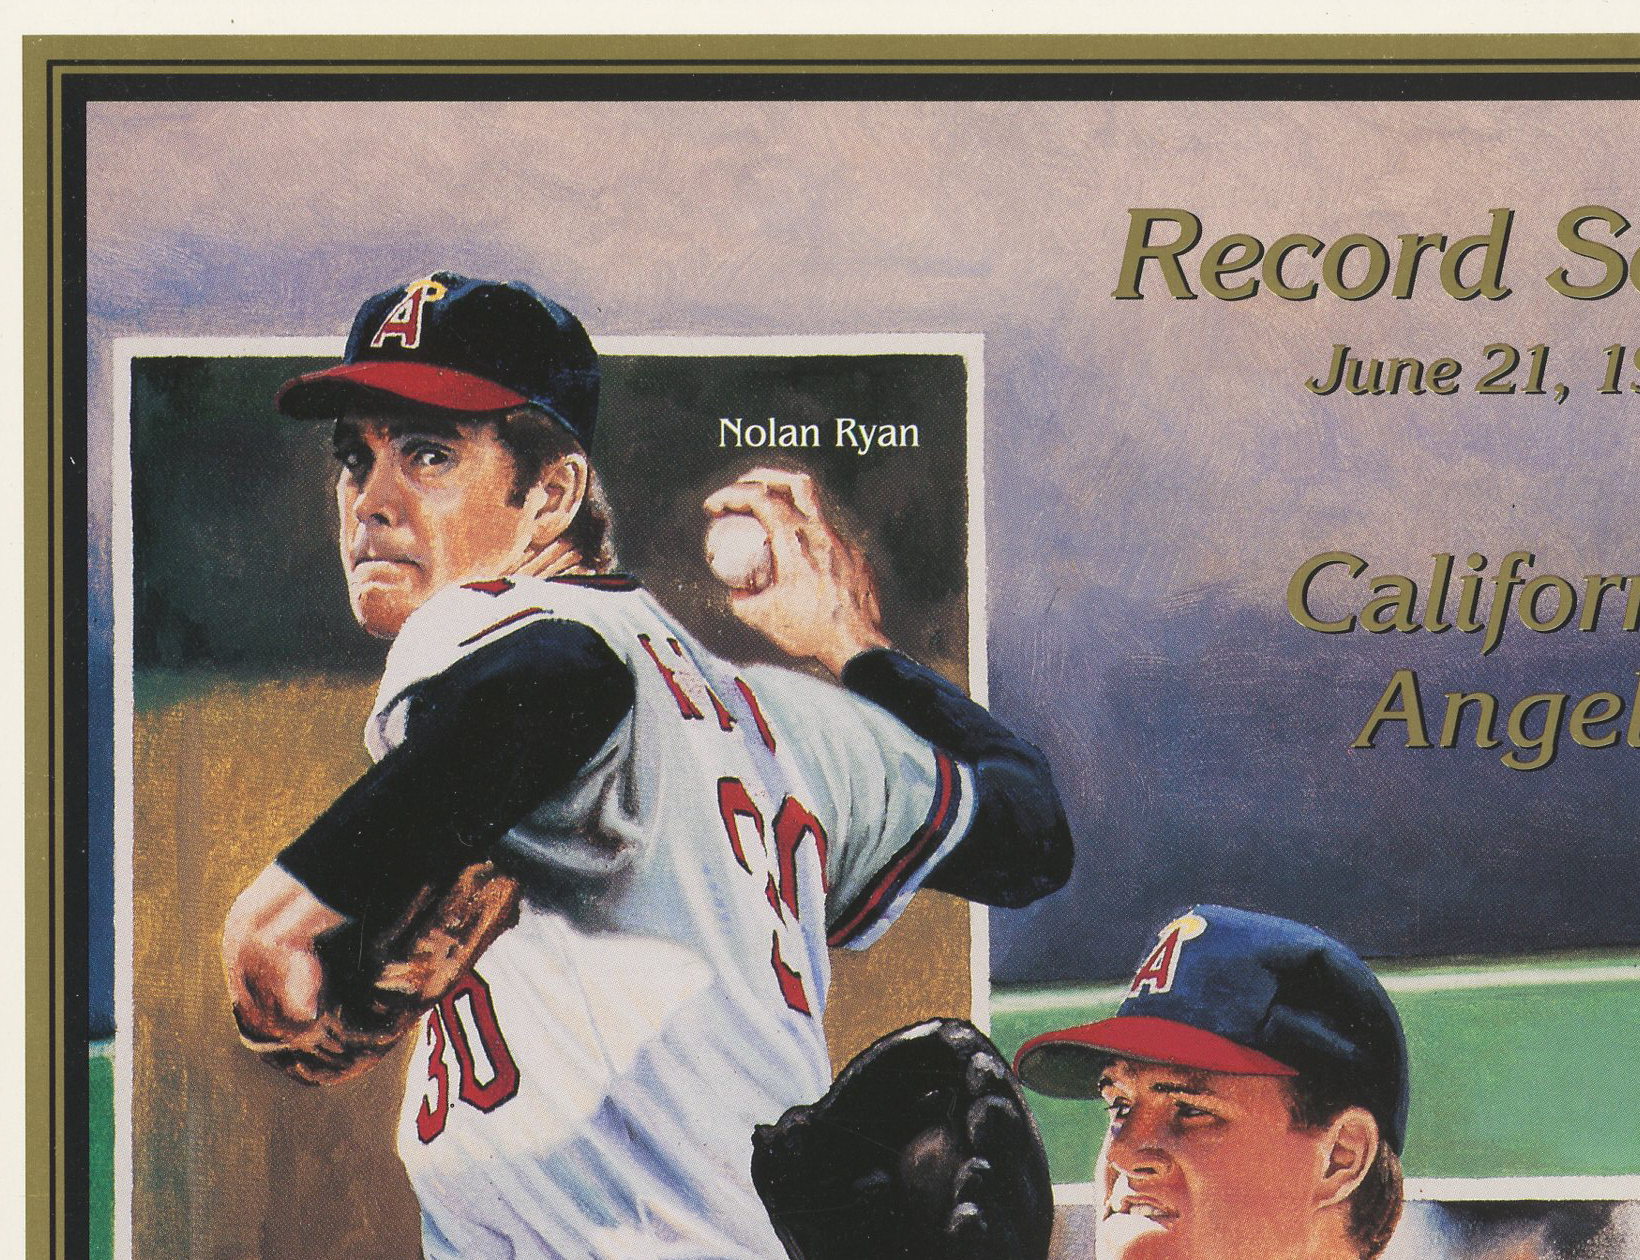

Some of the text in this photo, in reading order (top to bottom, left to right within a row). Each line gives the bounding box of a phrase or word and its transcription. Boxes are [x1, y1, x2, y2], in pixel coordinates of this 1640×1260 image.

[1111, 206, 1511, 302] Record
[1305, 343, 1462, 397] June
[1475, 342, 1569, 403] 21,
[719, 417, 919, 455] Nolan Ryan
[416, 968, 521, 1145] 30
